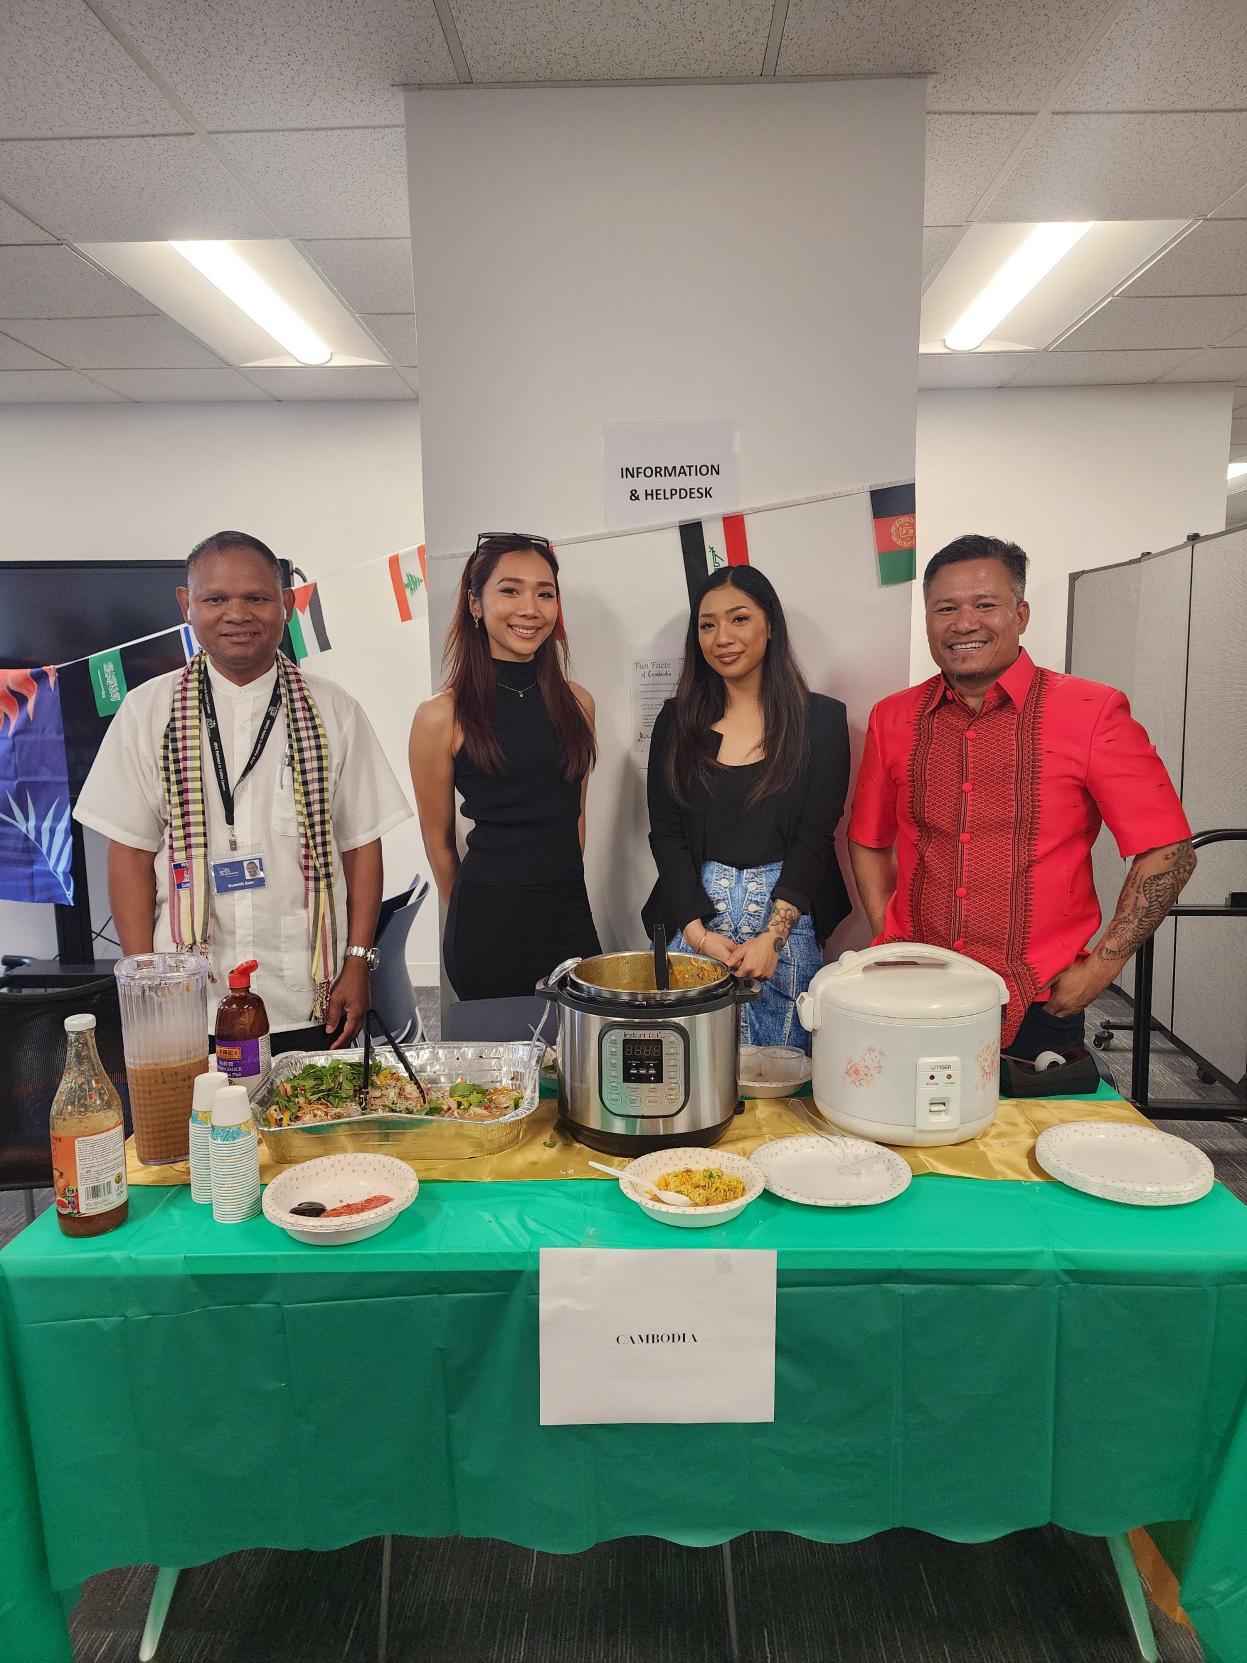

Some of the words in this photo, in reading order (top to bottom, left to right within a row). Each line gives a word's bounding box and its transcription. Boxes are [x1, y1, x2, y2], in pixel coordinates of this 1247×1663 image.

[620, 463, 720, 479] INFORMATION
[629, 488, 640, 501] &
[644, 486, 713, 501] HELPDESK
[633, 662, 649, 670] Fun
[650, 661, 671, 669] Facts
[616, 1333, 698, 1345] CAMBODIA
